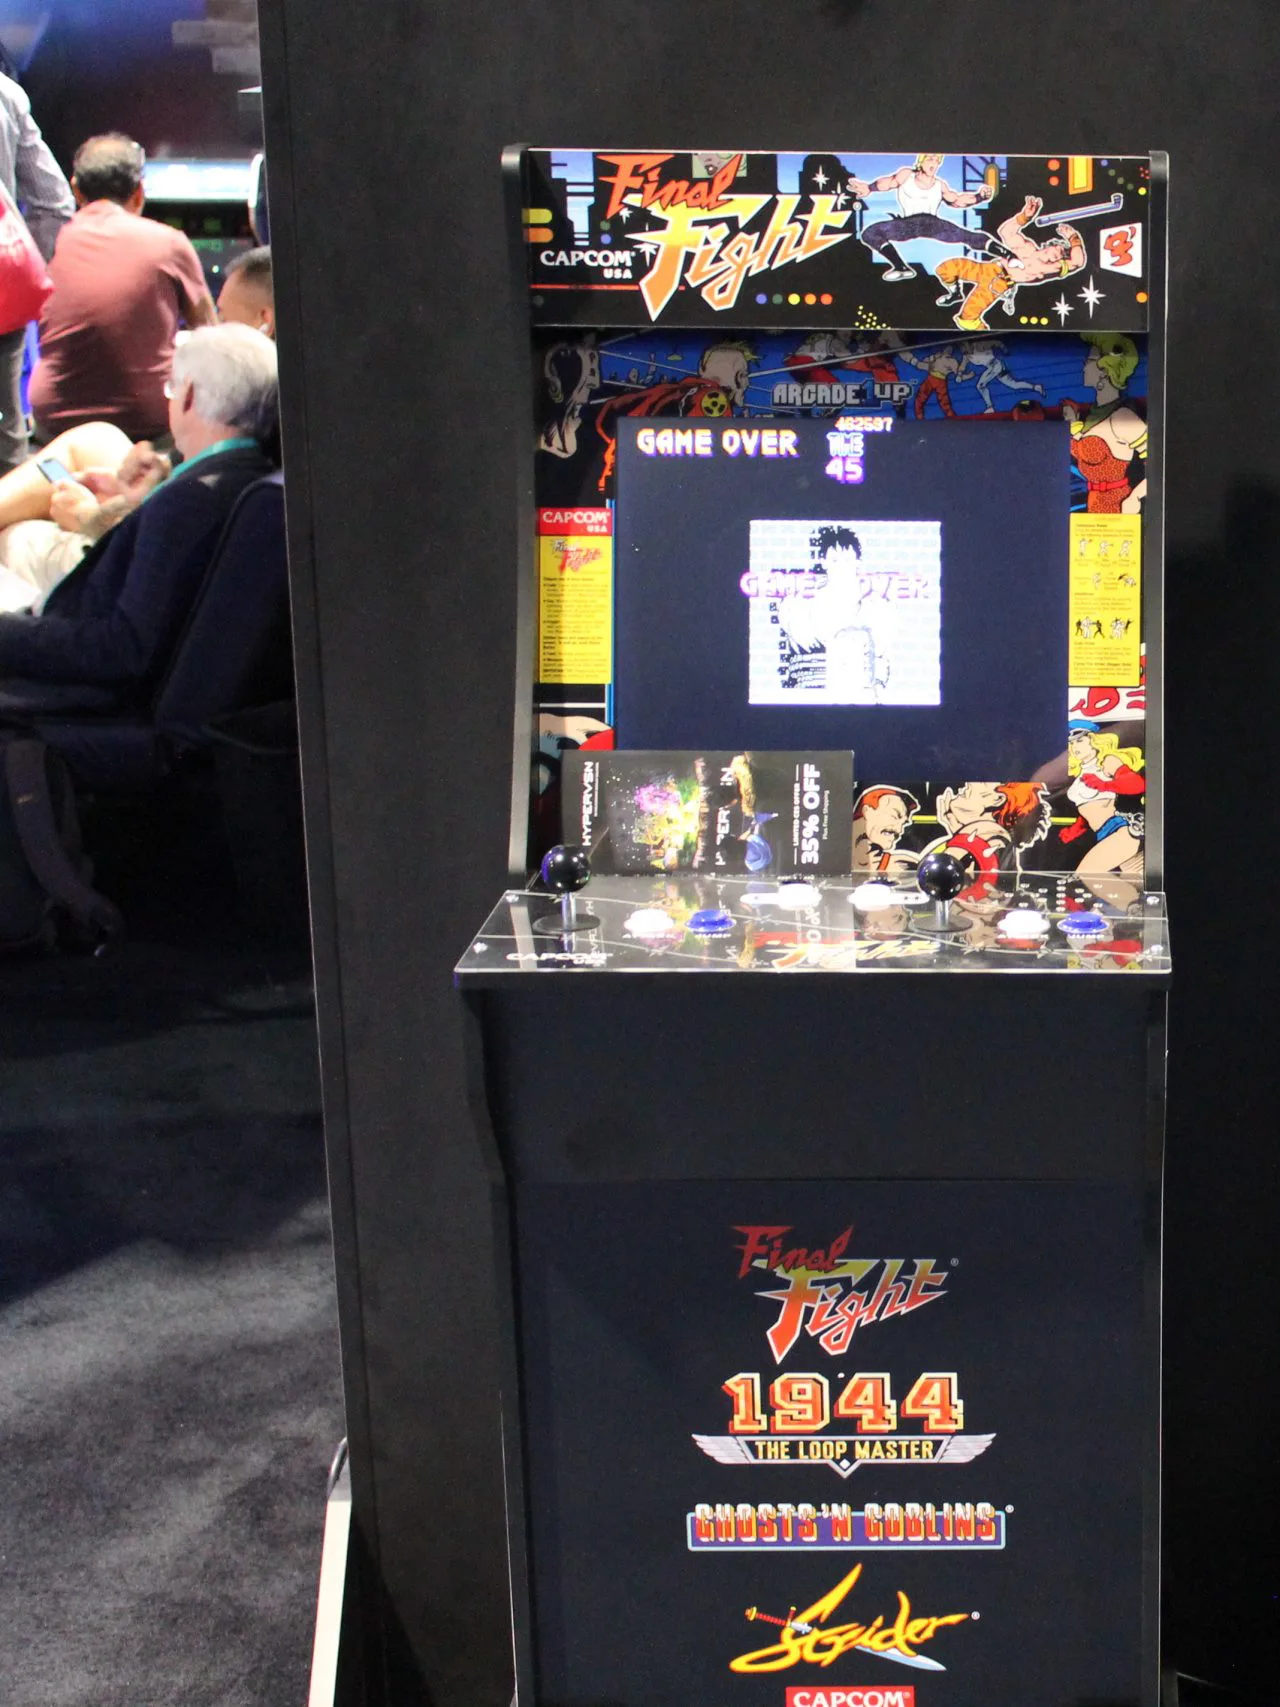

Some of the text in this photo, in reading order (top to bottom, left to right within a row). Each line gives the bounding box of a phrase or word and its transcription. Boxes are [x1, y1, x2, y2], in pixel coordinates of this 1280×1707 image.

[596, 153, 854, 322] Final Fight
[540, 250, 636, 266] CAPCOM
[603, 269, 633, 279] USA
[637, 428, 800, 457] GAME OVER
[825, 456, 864, 483] 45
[543, 511, 610, 524] CAPCOM
[581, 761, 594, 847] HYPERVSN
[801, 763, 820, 865] 35% OFF
[730, 1224, 950, 1365] Final Fight
[720, 1371, 965, 1434] 1944
[754, 1439, 935, 1461] THE LOOP MASTER
[864, 1502, 997, 1544] GOBLINS
[730, 1562, 969, 1673] Strider
[793, 1691, 906, 1707] CAPCOM
